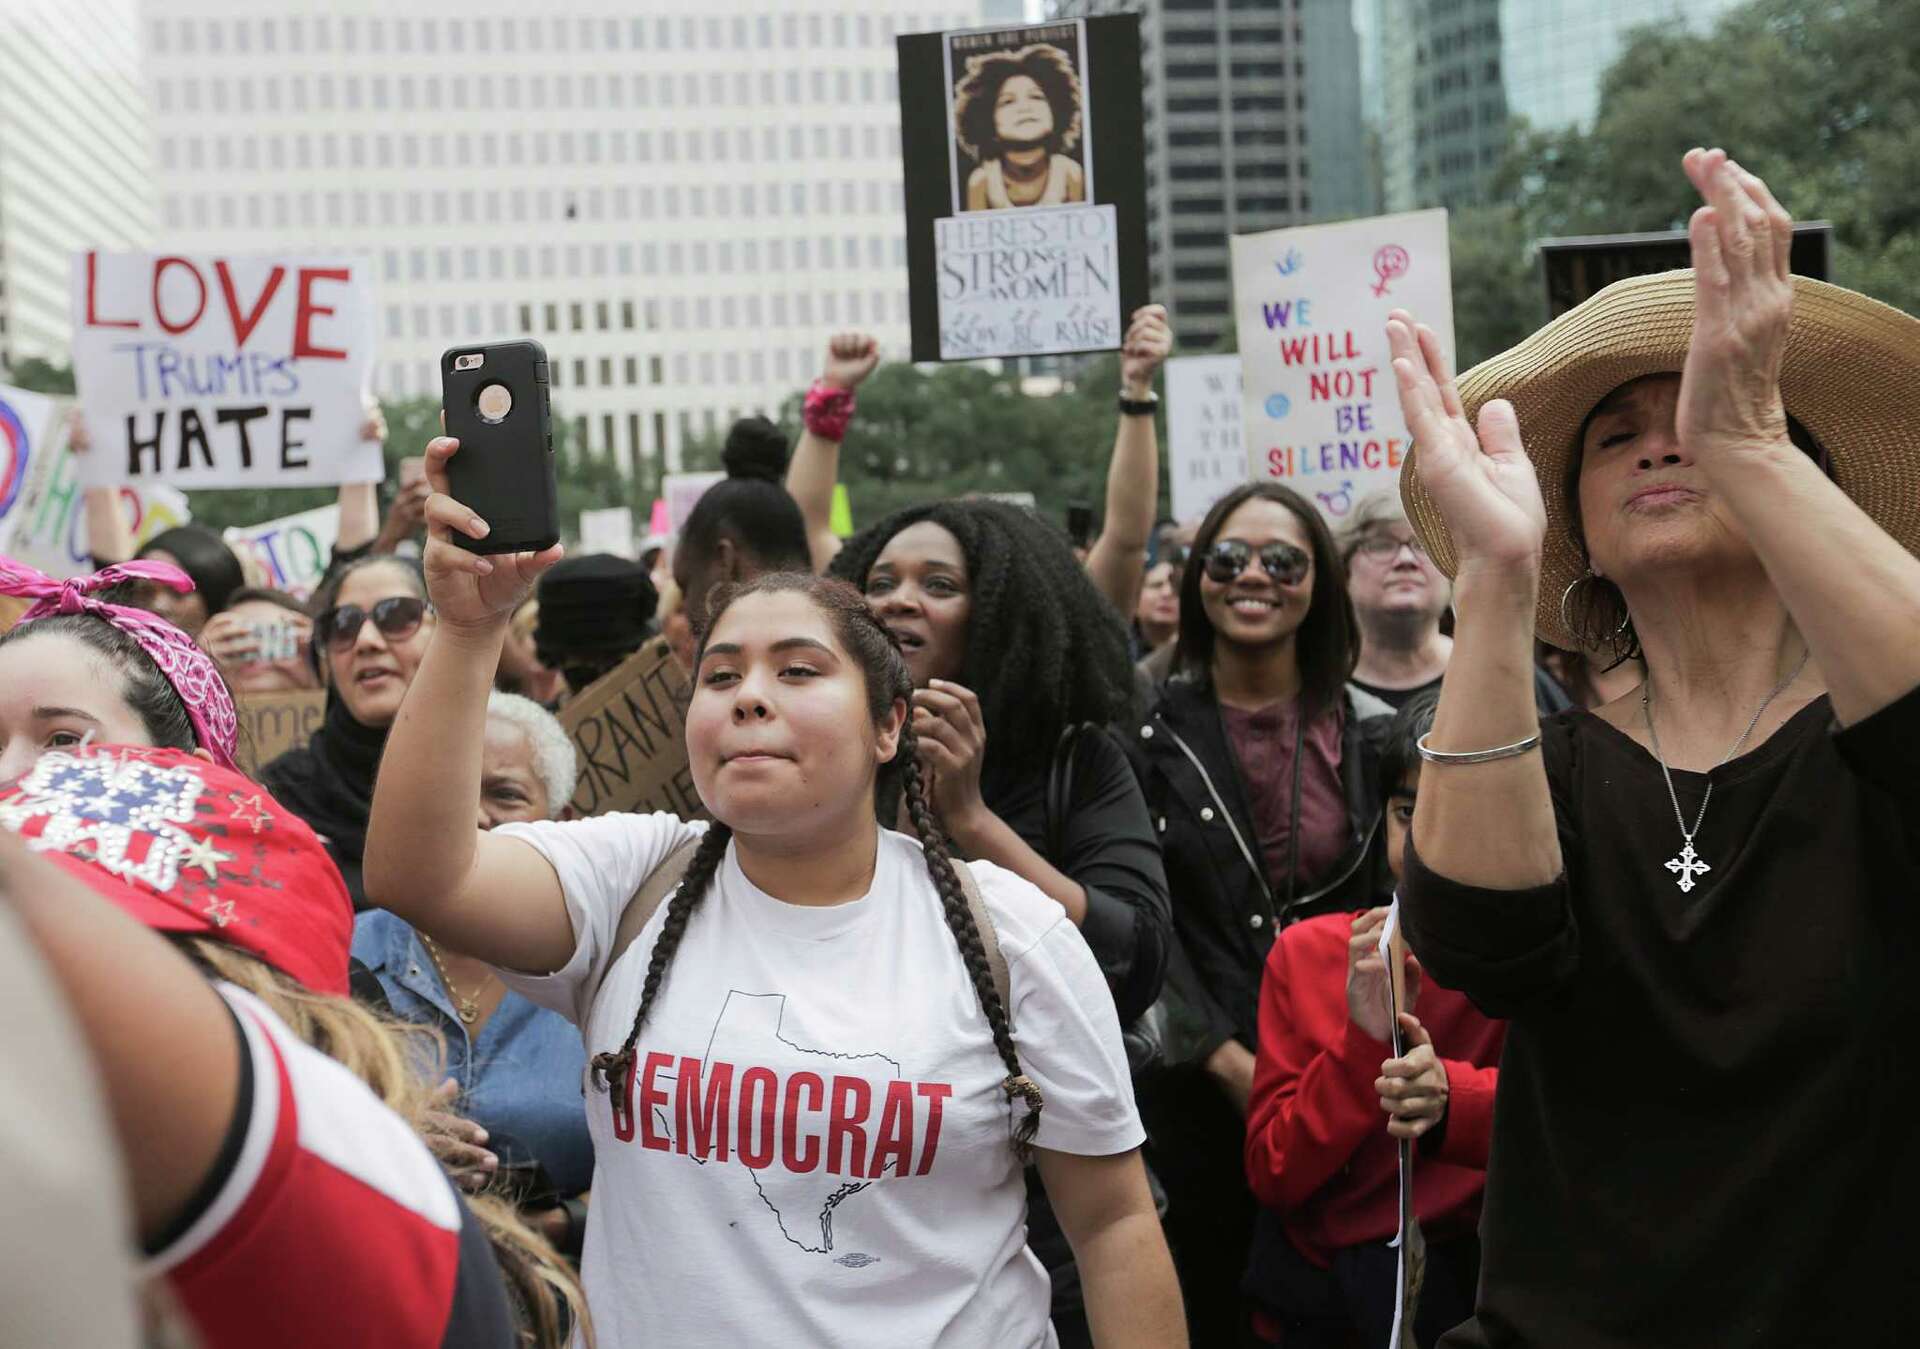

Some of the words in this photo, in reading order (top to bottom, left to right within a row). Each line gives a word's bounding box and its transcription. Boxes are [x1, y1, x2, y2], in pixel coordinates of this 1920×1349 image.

[86, 252, 349, 359] LOVE
[1264, 299, 1311, 328] WE
[1281, 331, 1360, 365] WILL
[111, 342, 301, 397] TRUMPS
[1311, 369, 1378, 400] NOT
[1337, 404, 1373, 433] BE
[127, 407, 311, 474] HATE
[1268, 438, 1409, 477] SILENCE
[611, 1049, 952, 1178] DEMOCRAT
